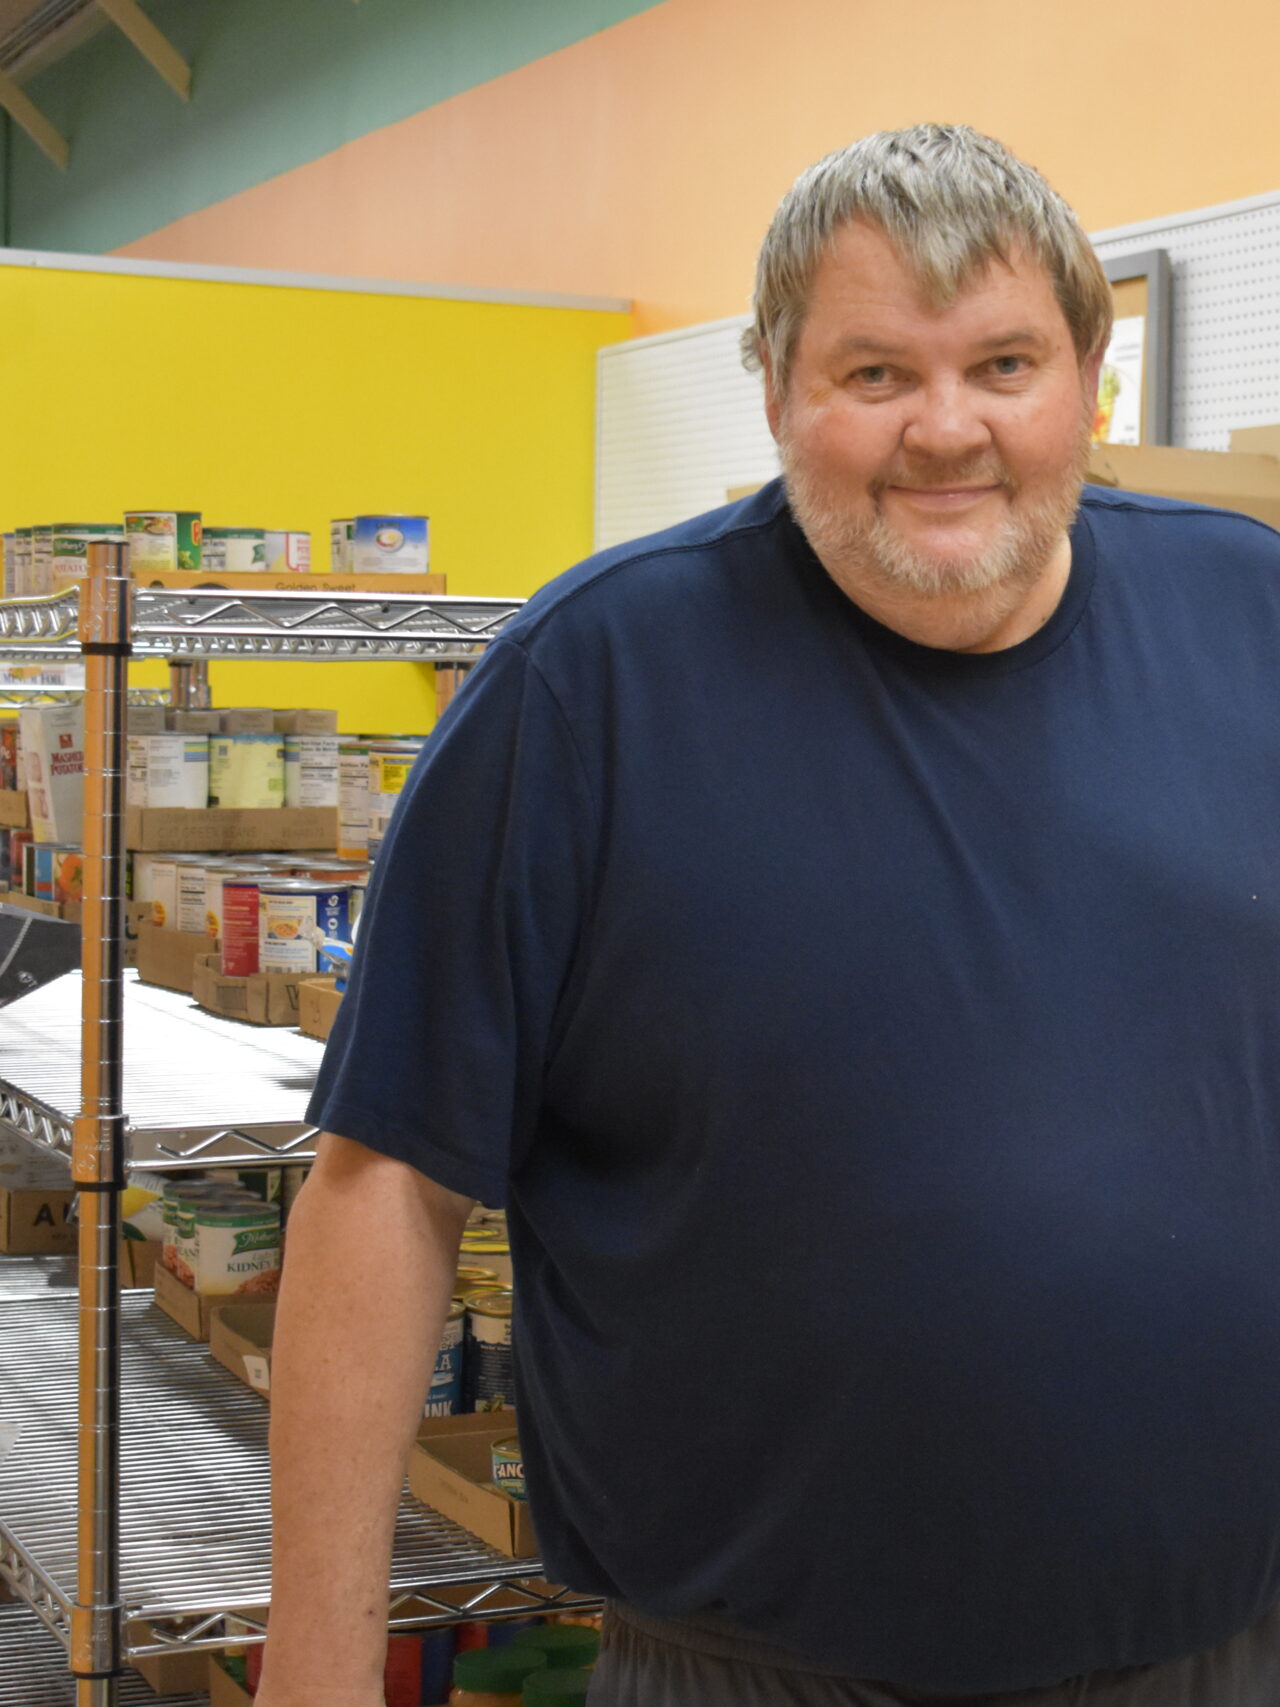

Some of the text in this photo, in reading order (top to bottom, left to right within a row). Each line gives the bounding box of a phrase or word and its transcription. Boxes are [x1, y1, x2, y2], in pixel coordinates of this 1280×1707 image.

[227, 1261, 273, 1273] KIDNEY
[424, 1401, 452, 1418] INK
[494, 1462, 524, 1481] FANC
